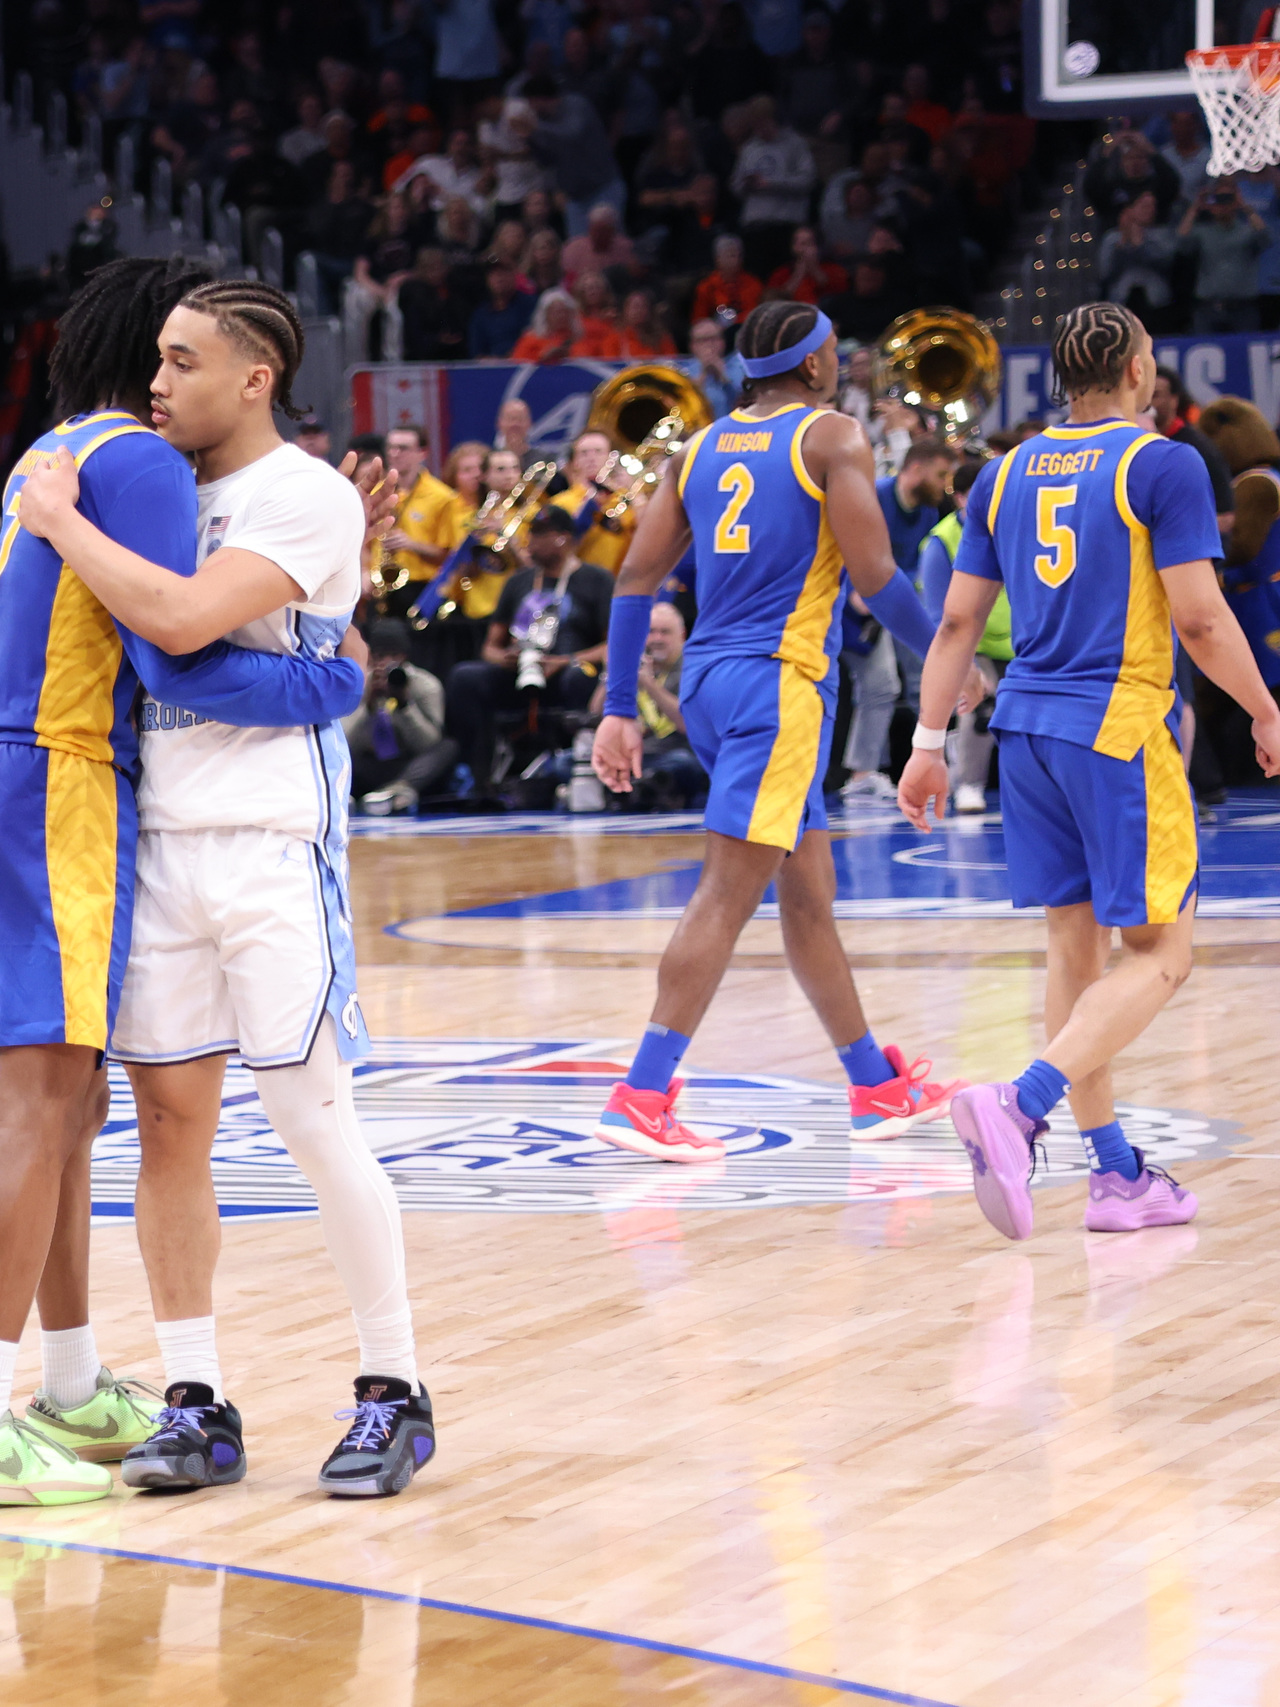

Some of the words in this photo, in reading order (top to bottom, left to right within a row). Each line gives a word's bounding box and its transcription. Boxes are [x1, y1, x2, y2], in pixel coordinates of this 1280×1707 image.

[715, 431, 773, 453] HINSON
[1025, 449, 1104, 476] LEGGETT
[713, 462, 754, 553] 2
[1034, 484, 1078, 589] 5
